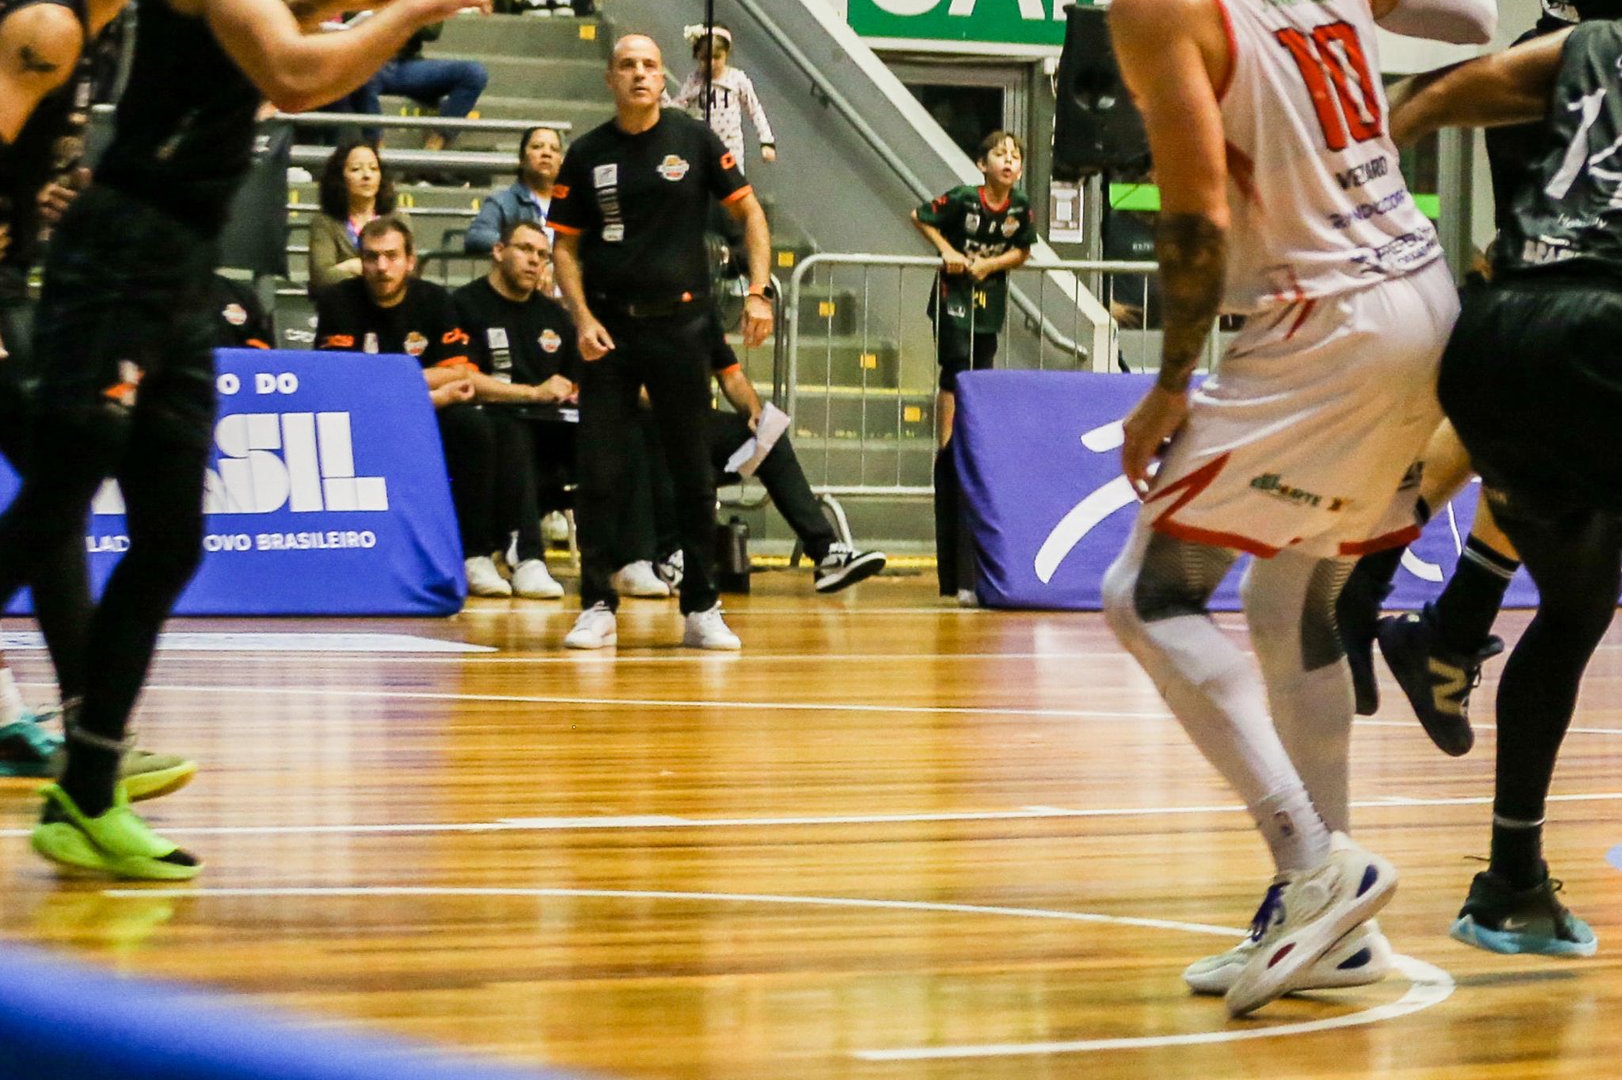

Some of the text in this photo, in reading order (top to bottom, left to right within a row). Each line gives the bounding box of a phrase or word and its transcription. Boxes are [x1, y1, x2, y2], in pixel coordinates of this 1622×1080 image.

[1273, 19, 1384, 153] 10
[255, 372, 299, 395] DO
[85, 530, 377, 553] LAD OVO BRASILEIRO
